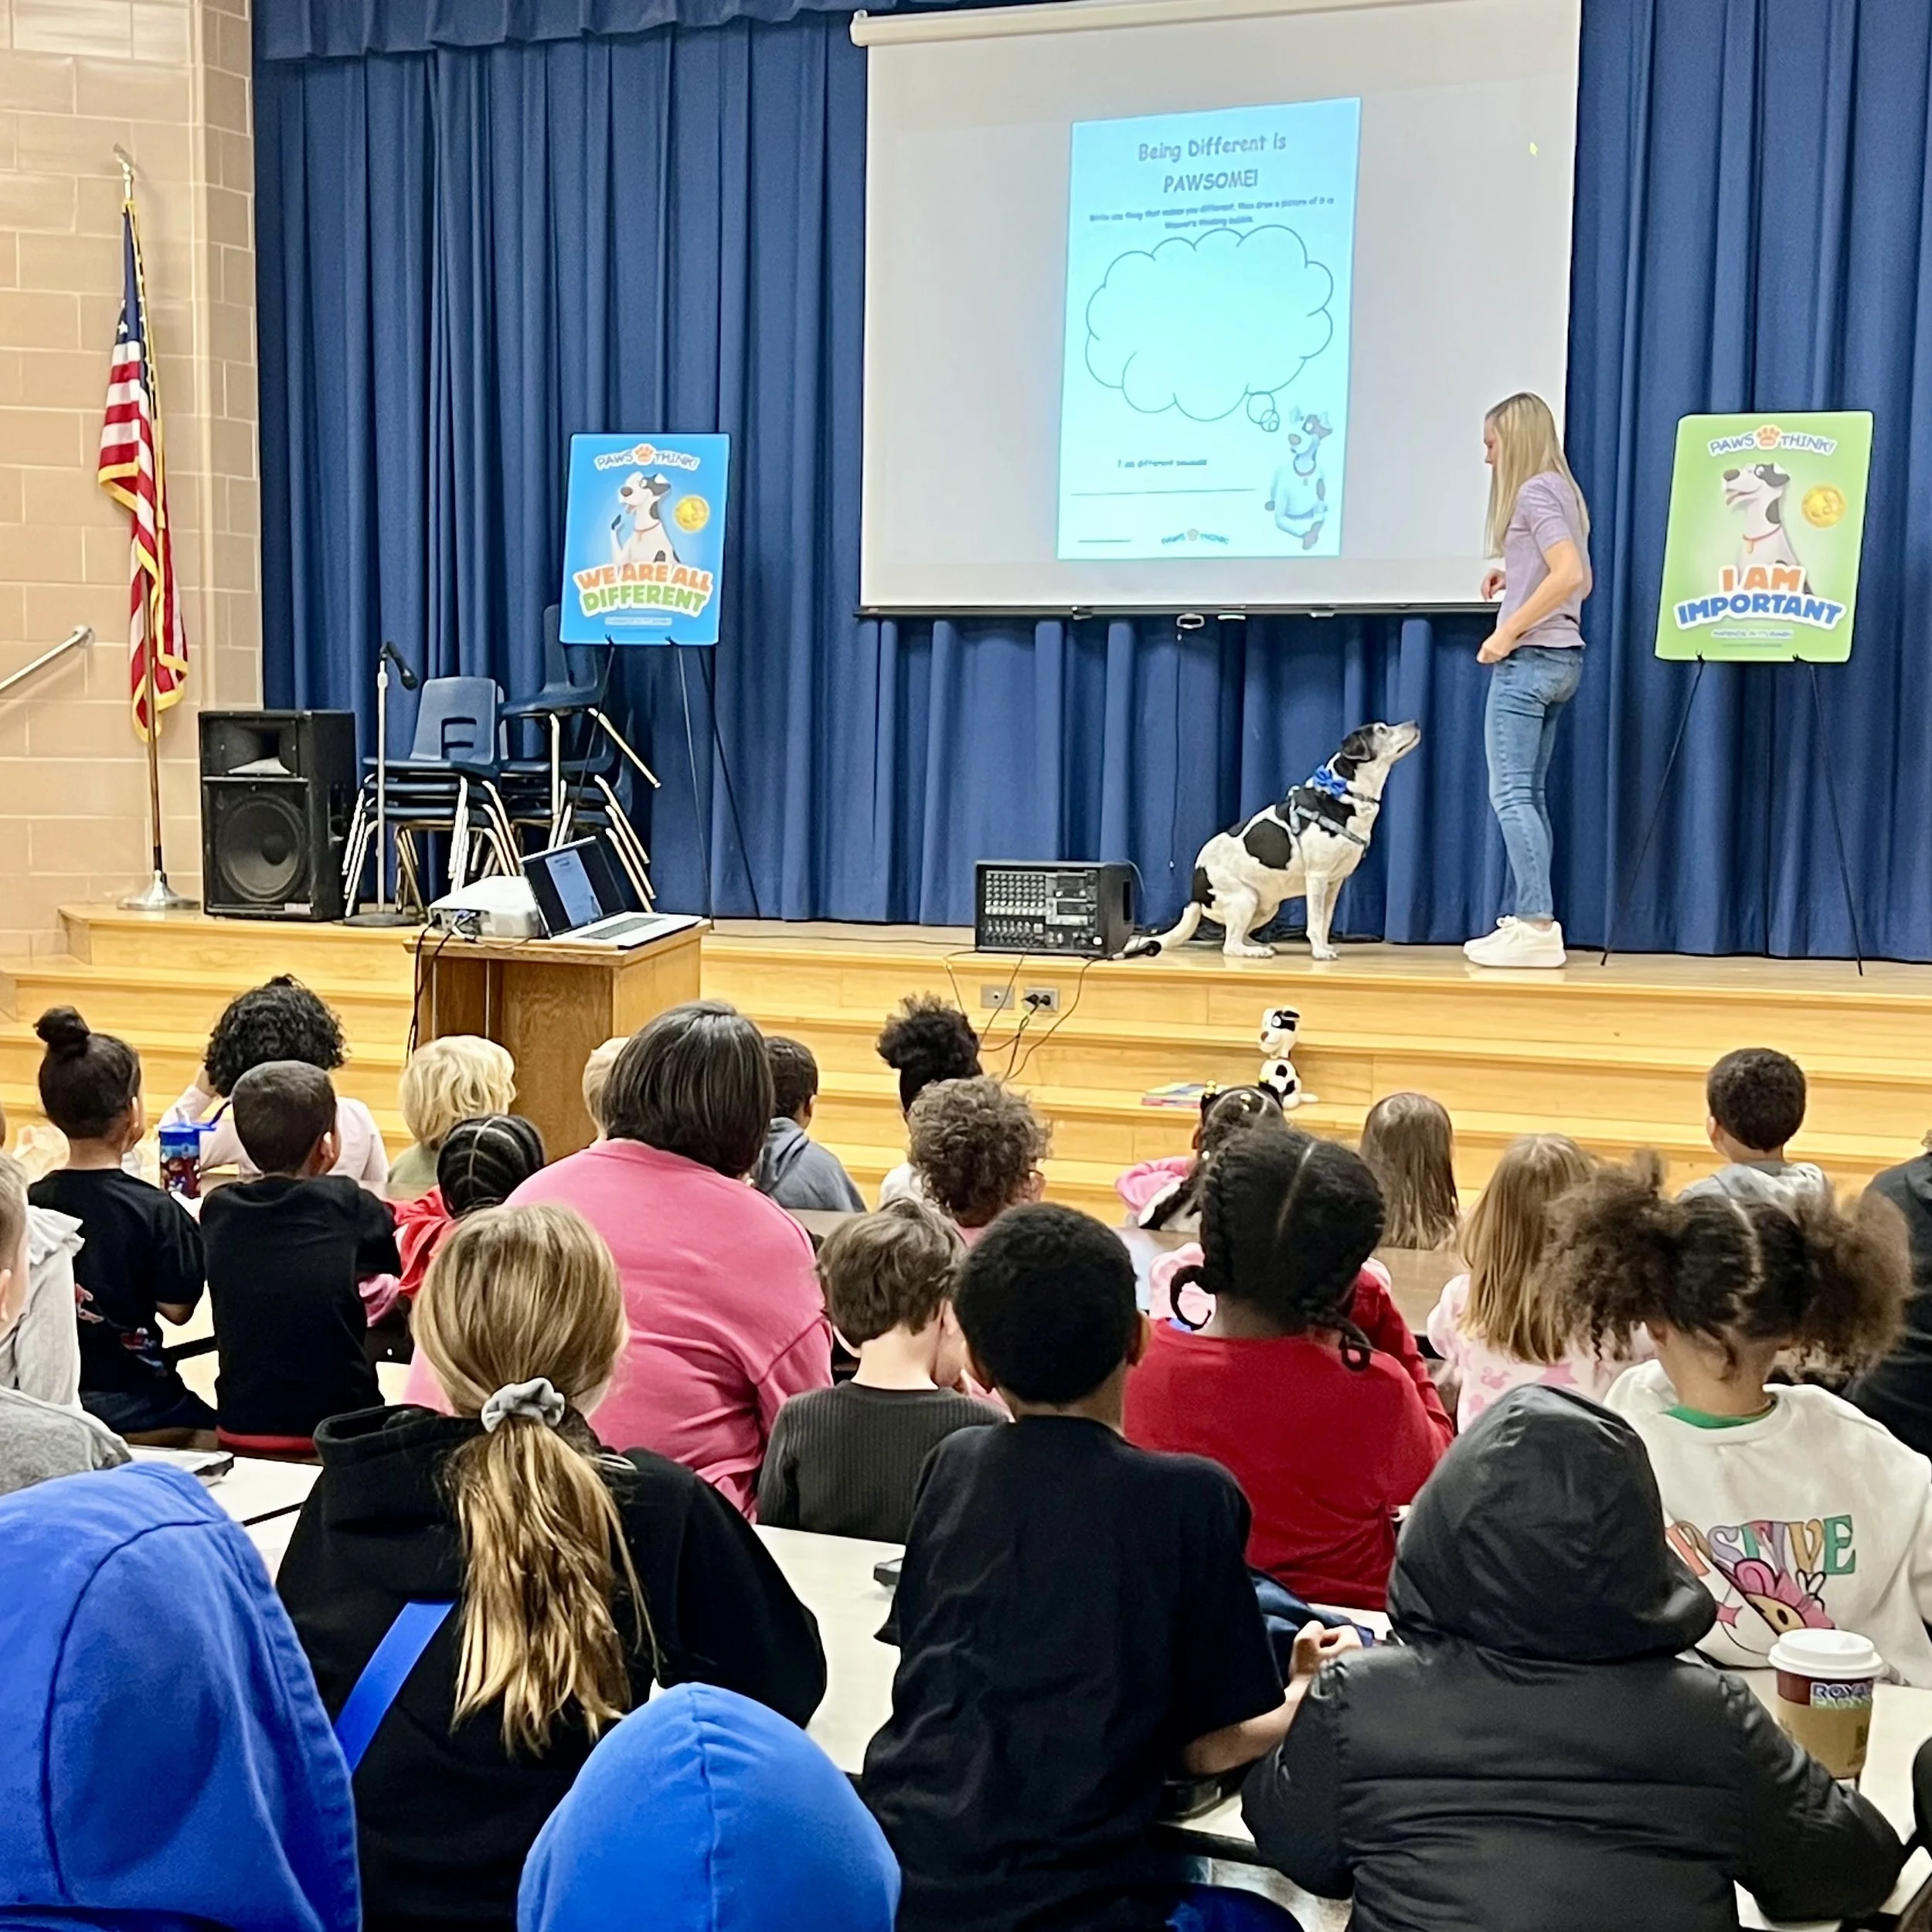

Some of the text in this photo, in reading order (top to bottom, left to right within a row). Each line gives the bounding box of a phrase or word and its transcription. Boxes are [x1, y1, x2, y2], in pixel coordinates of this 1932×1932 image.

[1138, 142, 1181, 163] Being
[1188, 134, 1267, 157] Different
[1710, 434, 1835, 453] PAWS THINK!
[597, 453, 699, 468] PAWS THINK!
[577, 563, 711, 592] WE ARE ALL
[1723, 567, 1801, 591] I AM
[583, 585, 706, 613] DIFFERENT
[1677, 594, 1842, 625] IMPORTANT
[1812, 1684, 1871, 1699] ROYA
